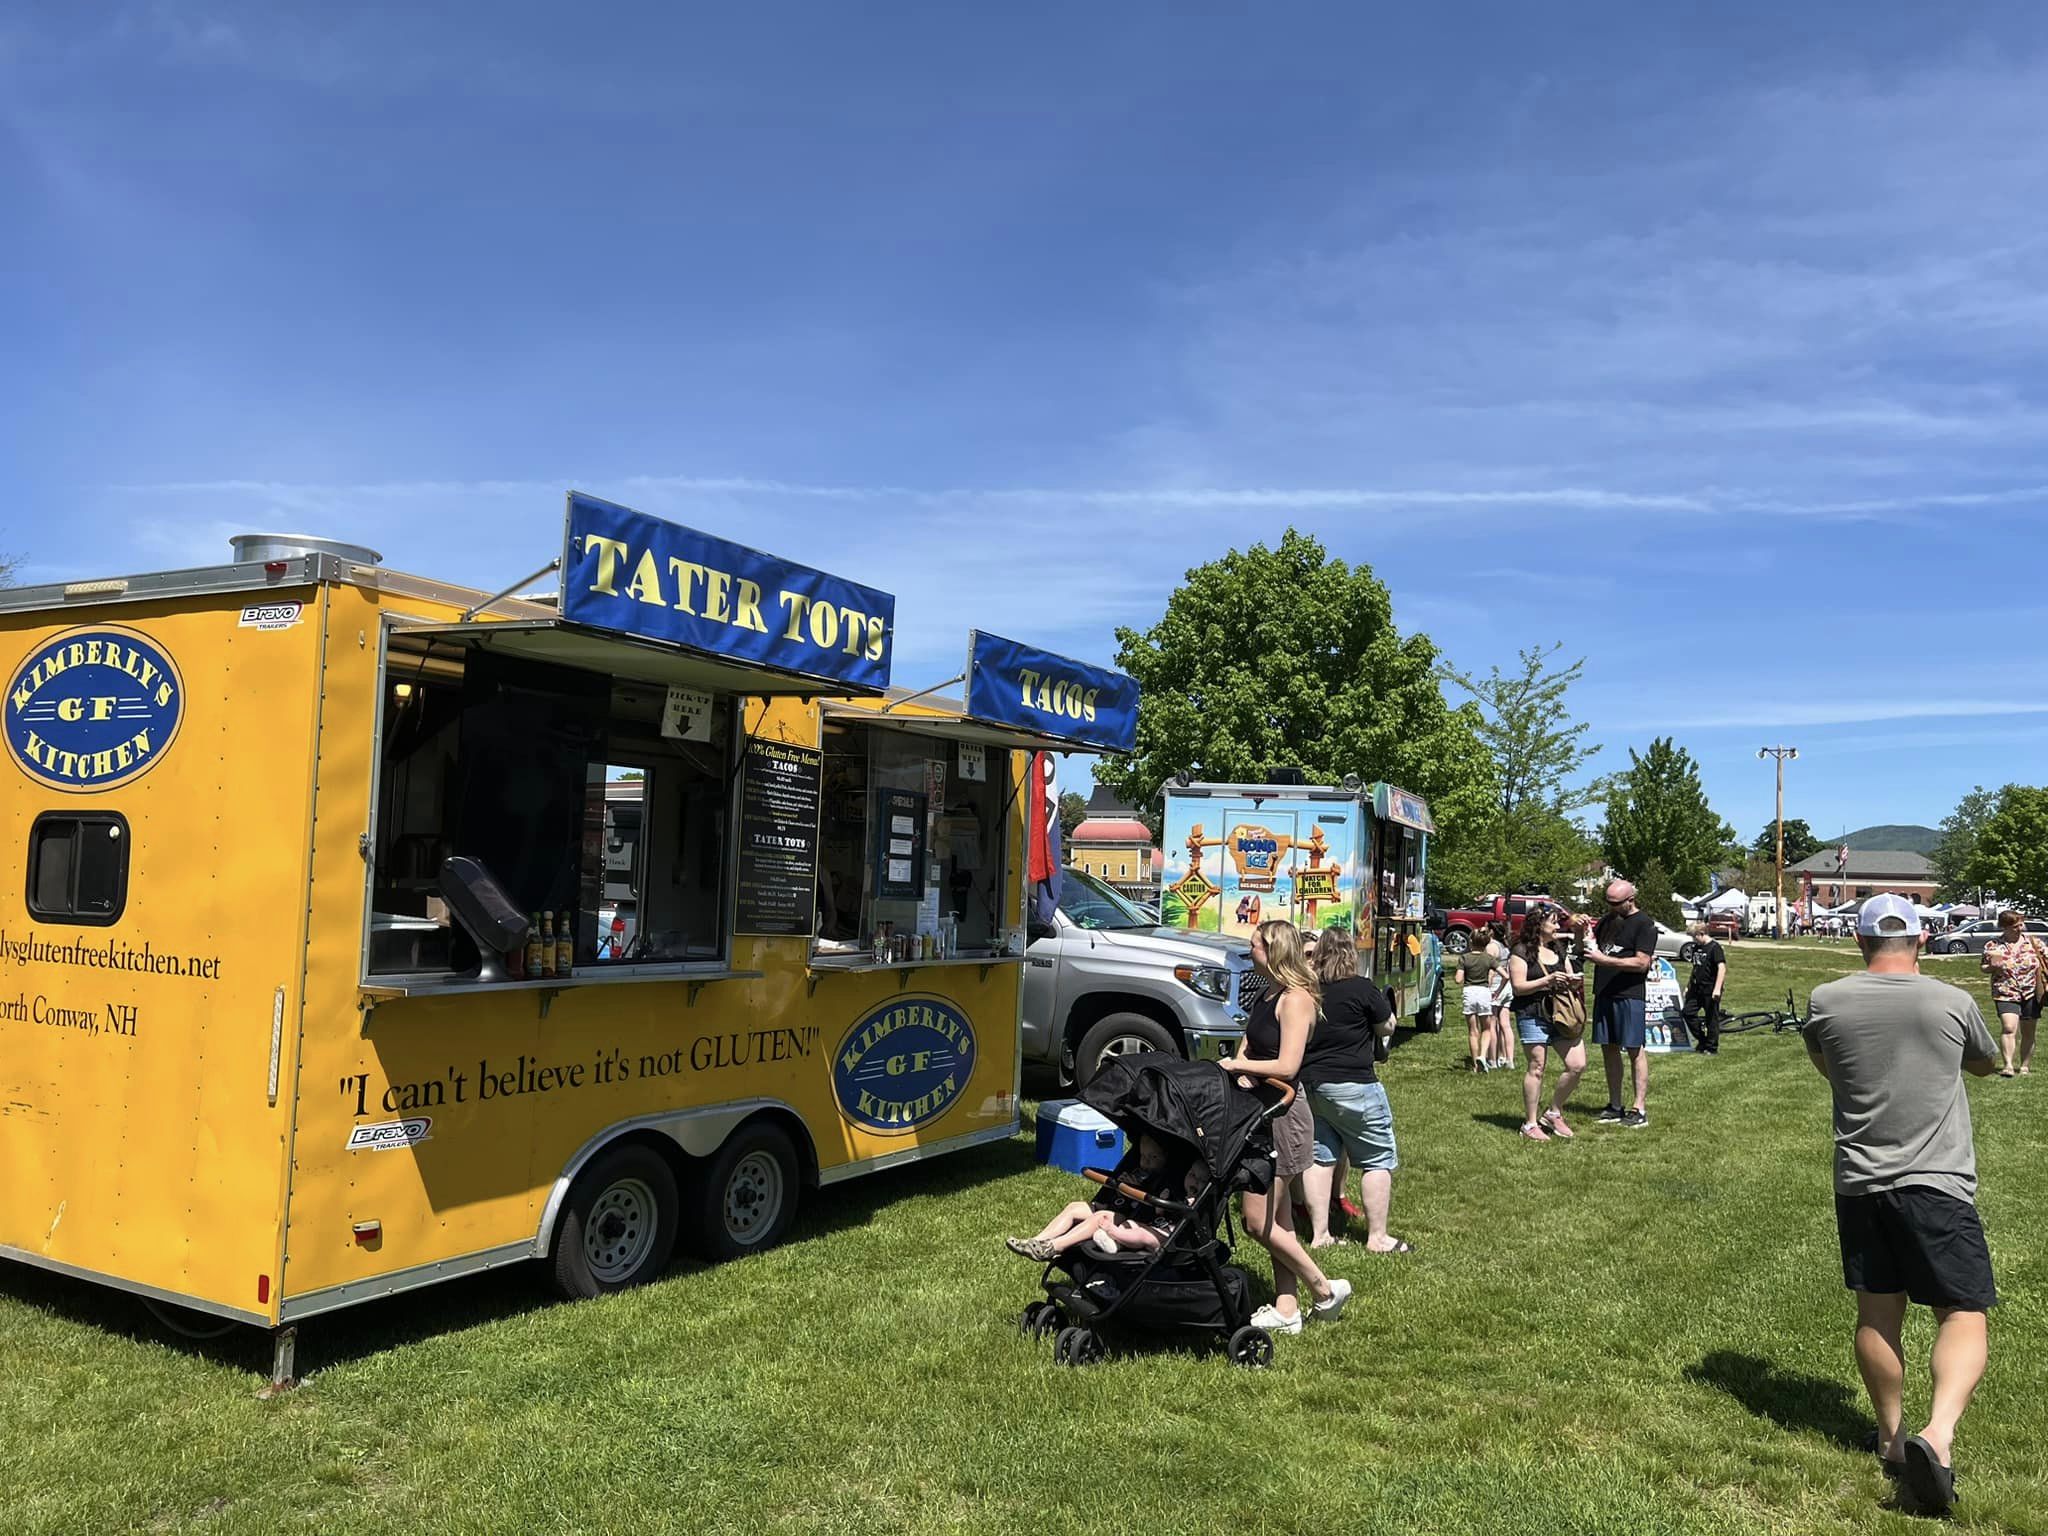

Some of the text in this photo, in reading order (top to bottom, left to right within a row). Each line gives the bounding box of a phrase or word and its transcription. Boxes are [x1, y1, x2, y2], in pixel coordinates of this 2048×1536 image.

[585, 534, 884, 661] TATER TOTS
[242, 604, 296, 623] Bravo
[258, 622, 288, 630] TRAILERS
[11, 640, 174, 714] KIMBERLY'S
[1018, 668, 1100, 722] TACOS
[24, 727, 152, 779] KITCHEN
[765, 745, 787, 760] Gluten
[800, 753, 820, 766] Menu!
[772, 760, 798, 773] TACOS
[754, 833, 806, 848] TATER TOTS
[1237, 838, 1277, 853] KONA
[1246, 853, 1269, 868] ICE
[1182, 883, 1206, 893] CAUTION
[33, 995, 99, 1037] Conway,
[105, 1003, 138, 1037] NH
[843, 1005, 972, 1074] KIMBERLY'S
[339, 1026, 820, 1117] "I can't believe it's not GLUTEN!"
[855, 1071, 957, 1124] KITCHEN
[352, 1123, 421, 1143] Bravo
